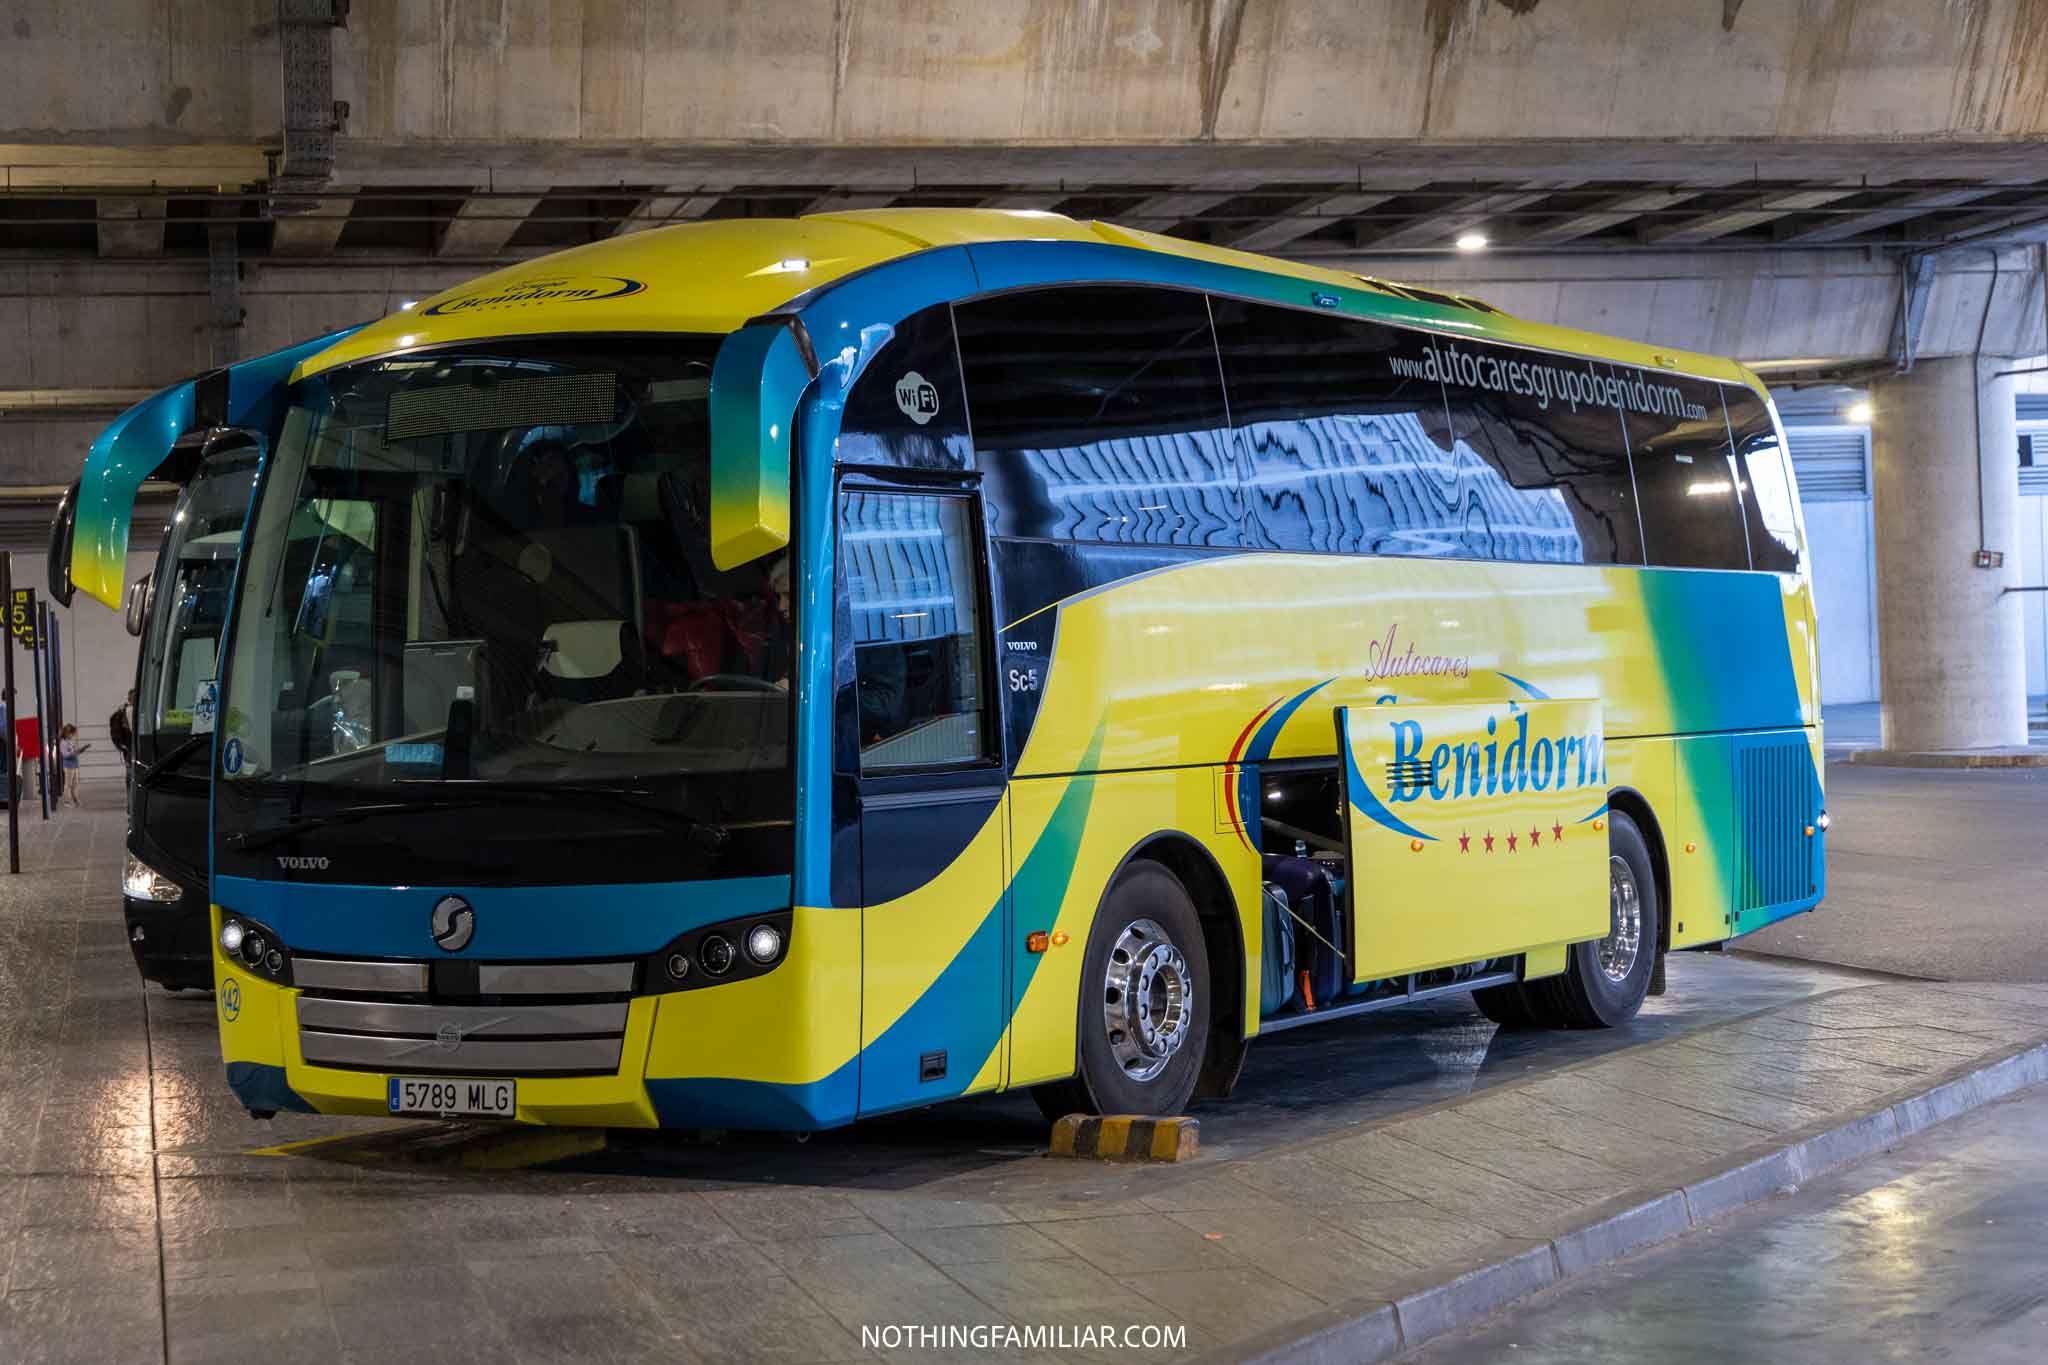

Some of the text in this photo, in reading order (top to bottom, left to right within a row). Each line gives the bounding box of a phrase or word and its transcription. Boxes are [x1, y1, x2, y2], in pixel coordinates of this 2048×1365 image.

[1389, 344, 1708, 420] www.autocaresgrupobenidorm.com
[1007, 641, 1038, 651] VOLVO
[1365, 624, 1472, 682] Autocares
[1389, 711, 1607, 804] Benidorm
[277, 856, 329, 870] VOLVO
[405, 1083, 509, 1111] 5789 MLG
